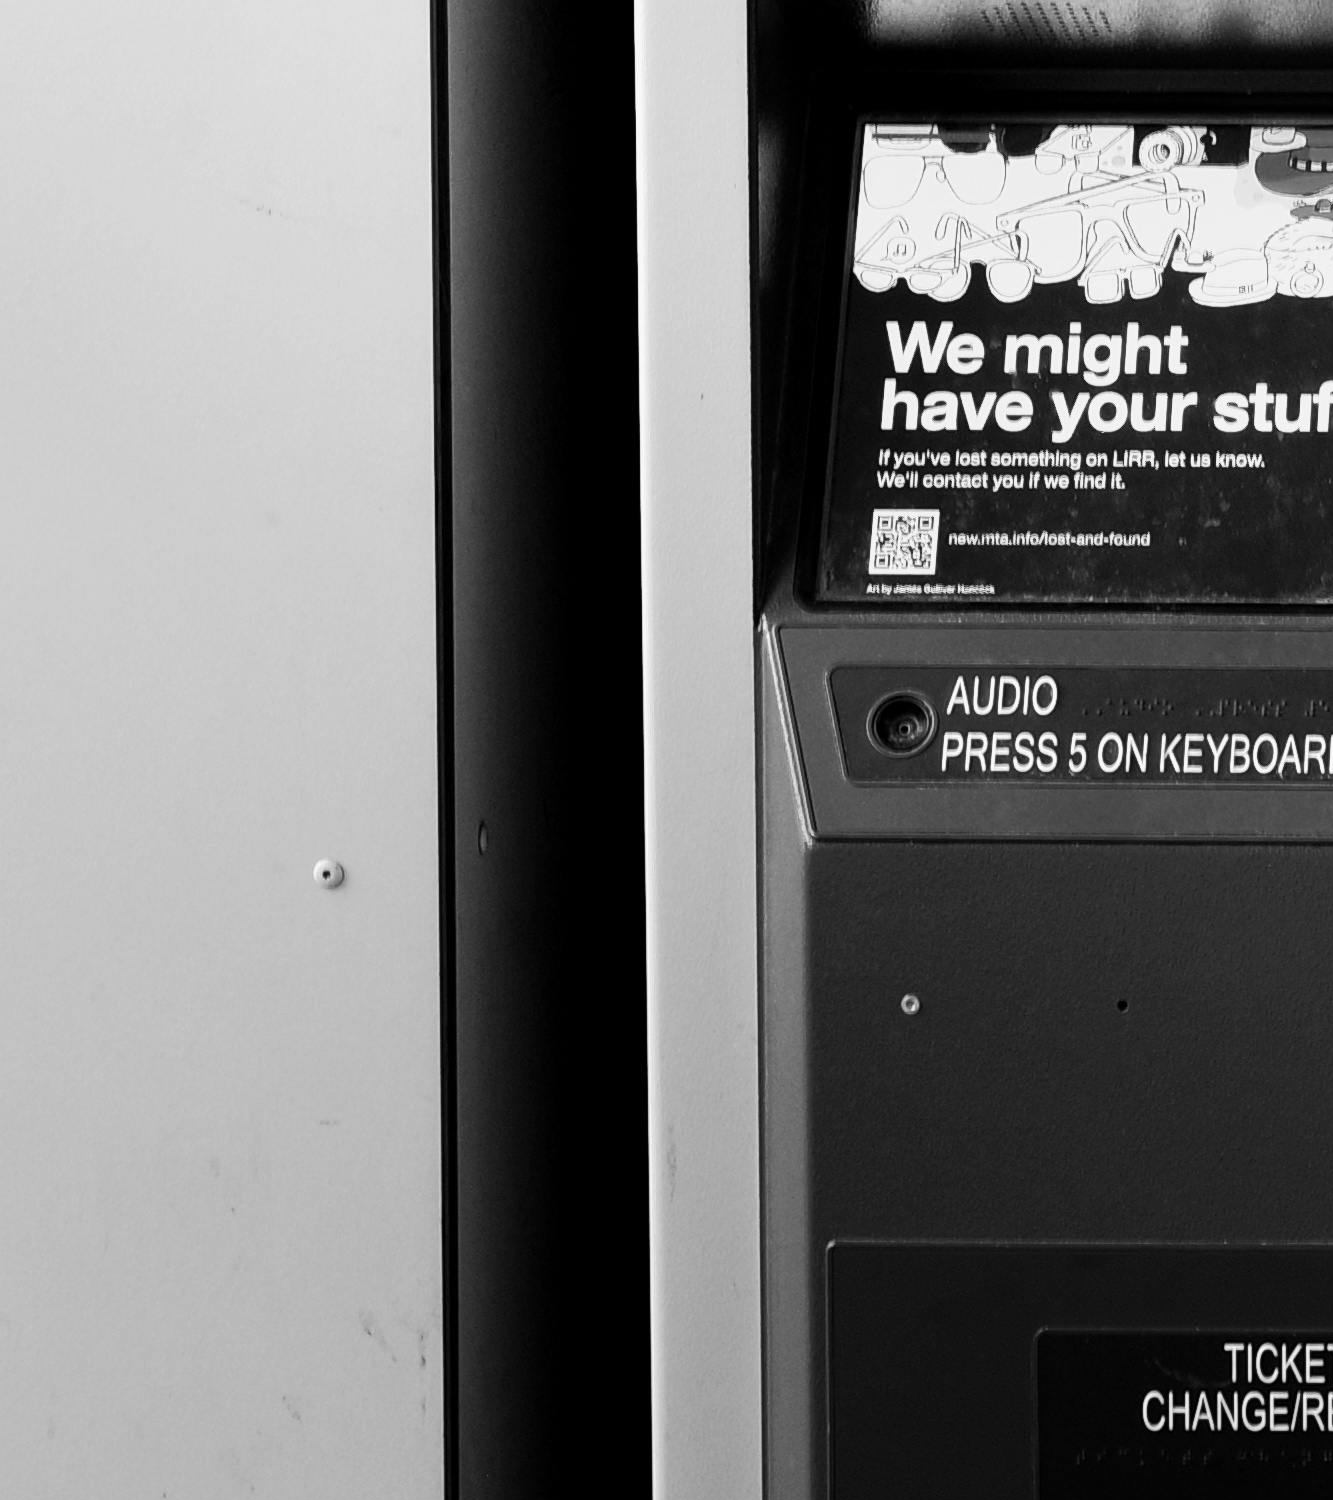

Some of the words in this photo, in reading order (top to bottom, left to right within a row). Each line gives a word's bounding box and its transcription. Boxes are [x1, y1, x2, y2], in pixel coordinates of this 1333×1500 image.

[886, 321, 984, 374] We
[1004, 322, 1188, 385] might
[881, 378, 1033, 431] have
[1052, 391, 1197, 443] your
[879, 449, 891, 466] If
[894, 450, 950, 470] you've
[956, 449, 986, 466] lost
[991, 450, 1081, 470] something
[1086, 453, 1107, 467] on
[1113, 451, 1159, 470] LIRR,
[1165, 451, 1186, 467] let
[1191, 454, 1211, 468] us
[1215, 452, 1265, 468] know.
[877, 472, 918, 488] We'll
[923, 472, 988, 489] contact
[993, 475, 1024, 492] you
[1029, 472, 1039, 489] if
[1044, 475, 1069, 488] we
[1074, 472, 1106, 489] find
[1111, 472, 1125, 489] it.
[947, 676, 1057, 715] AUDIO
[942, 732, 1057, 772] PRESS
[1069, 733, 1086, 772] 5
[1098, 732, 1148, 772] ON
